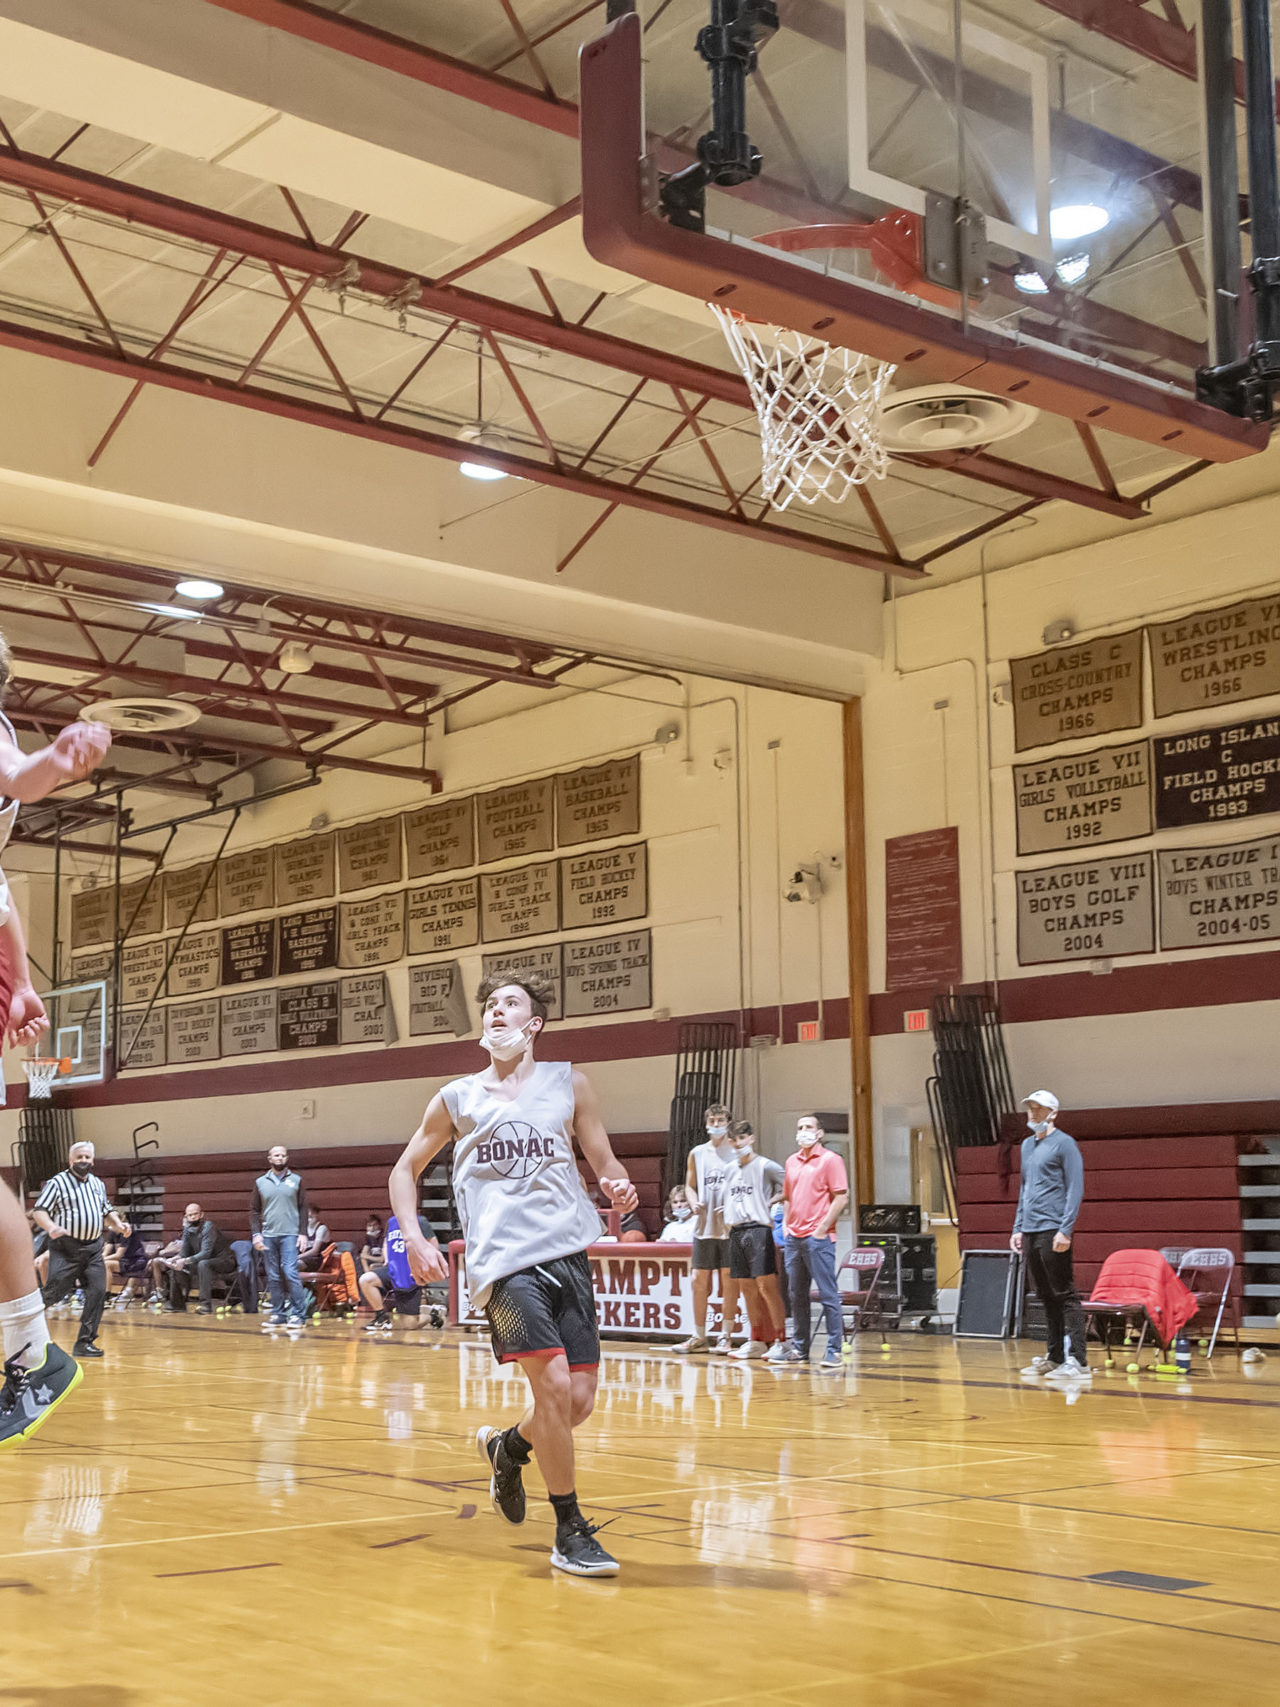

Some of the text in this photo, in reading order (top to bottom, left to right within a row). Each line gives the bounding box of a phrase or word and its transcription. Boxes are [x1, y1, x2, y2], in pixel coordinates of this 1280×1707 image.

[1162, 610, 1247, 645] LEAGUE
[1163, 625, 1280, 666] WRESTLING
[1032, 645, 1122, 678] CLASS C
[1180, 650, 1267, 682] CHAMPS
[1204, 677, 1242, 698] 1966
[1039, 687, 1113, 716] CHAMPS
[1059, 712, 1094, 733] 1966
[1164, 735, 1211, 755] LONG
[1221, 749, 1233, 763] C
[563, 769, 612, 791] LEAGUE
[1022, 751, 1141, 788] LEAGUE VII
[1163, 769, 1218, 790] FIELD
[566, 783, 629, 807] BASEBALL
[1019, 772, 1146, 807] GIRLS VOLLEYBALL
[1190, 778, 1267, 803] CHAMPS
[574, 801, 622, 821] CHAMPS
[1044, 797, 1122, 823] CHAMPS
[1208, 799, 1249, 818] 1993
[493, 819, 537, 839] CHAMPS
[1066, 821, 1102, 840] 1992
[571, 852, 637, 874] LEAGUE V
[1171, 848, 1261, 874] LEAGUE
[490, 872, 529, 888] LEAGUE
[571, 868, 637, 890] FIELD HOCKEY
[1022, 862, 1145, 893] LEAGUE VIII
[1166, 867, 1280, 896] BOYS WINTER TR
[413, 887, 452, 904] LEAGUE
[579, 885, 629, 905] CHAMPS
[1028, 885, 1140, 913] BOYS GOLF
[1190, 890, 1278, 915] CHAMPS
[422, 916, 463, 933] CHAMPS
[501, 907, 541, 923] CHAMPS
[1044, 909, 1124, 932] CHAMPS
[1197, 914, 1270, 936] 2004-05
[571, 939, 641, 960] LEAGUE IV
[1064, 933, 1103, 951] 2004
[173, 948, 220, 965] YMNASTICS
[541, 952, 553, 964] IV
[581, 974, 631, 992] CHAMPS
[289, 1020, 327, 1034] CHAMPS
[477, 1138, 555, 1164] BONAC
[391, 1240, 405, 1253] 43
[848, 1252, 878, 1266] EHHS
